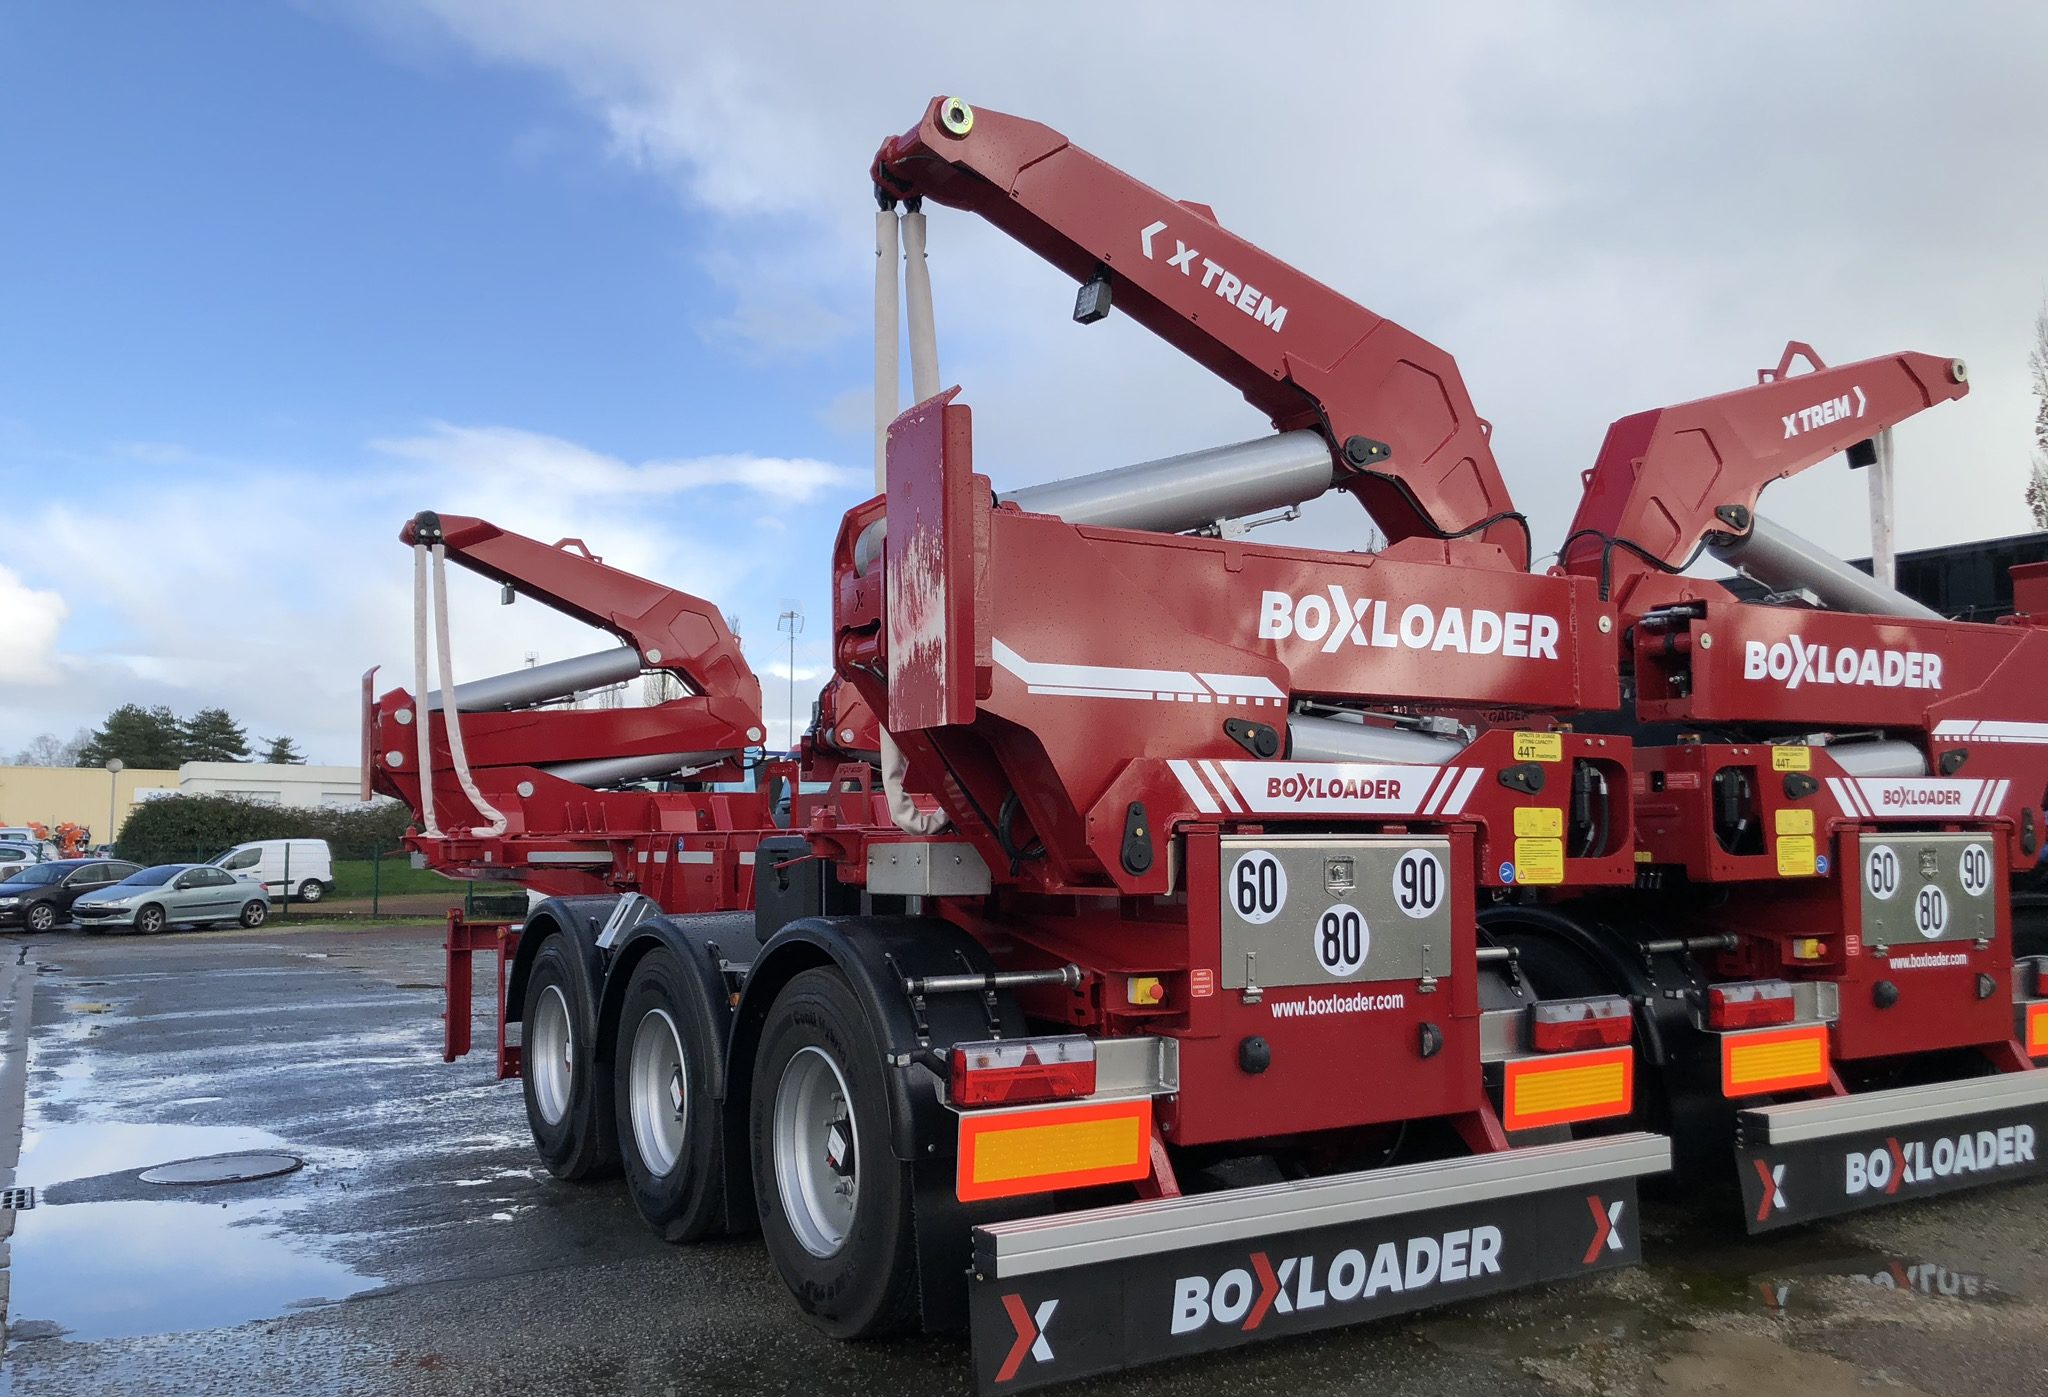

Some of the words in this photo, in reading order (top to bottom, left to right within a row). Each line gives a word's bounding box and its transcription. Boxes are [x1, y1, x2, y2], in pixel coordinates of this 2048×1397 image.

[1258, 584, 1560, 660] BOXLOADER
[1744, 634, 1942, 690] BOXLOADER
[1517, 745, 1536, 758] 44T
[1775, 758, 1790, 769] 44T
[1266, 772, 1401, 802] BOXLOADER
[1882, 786, 1961, 808] BOXLOADER
[1237, 858, 1278, 915] 60
[1400, 856, 1436, 910] 90
[1871, 852, 1894, 894] 60
[1963, 850, 1986, 889] 90
[1919, 890, 1942, 931] 80
[1321, 911, 1361, 966] 80
[1889, 952, 1968, 970] www.boxloader.com
[1271, 992, 1404, 1018] www.boxloader.com
[1845, 1124, 2036, 1196] BOXLOADER
[1170, 1224, 1503, 1331] BOXLOADER
